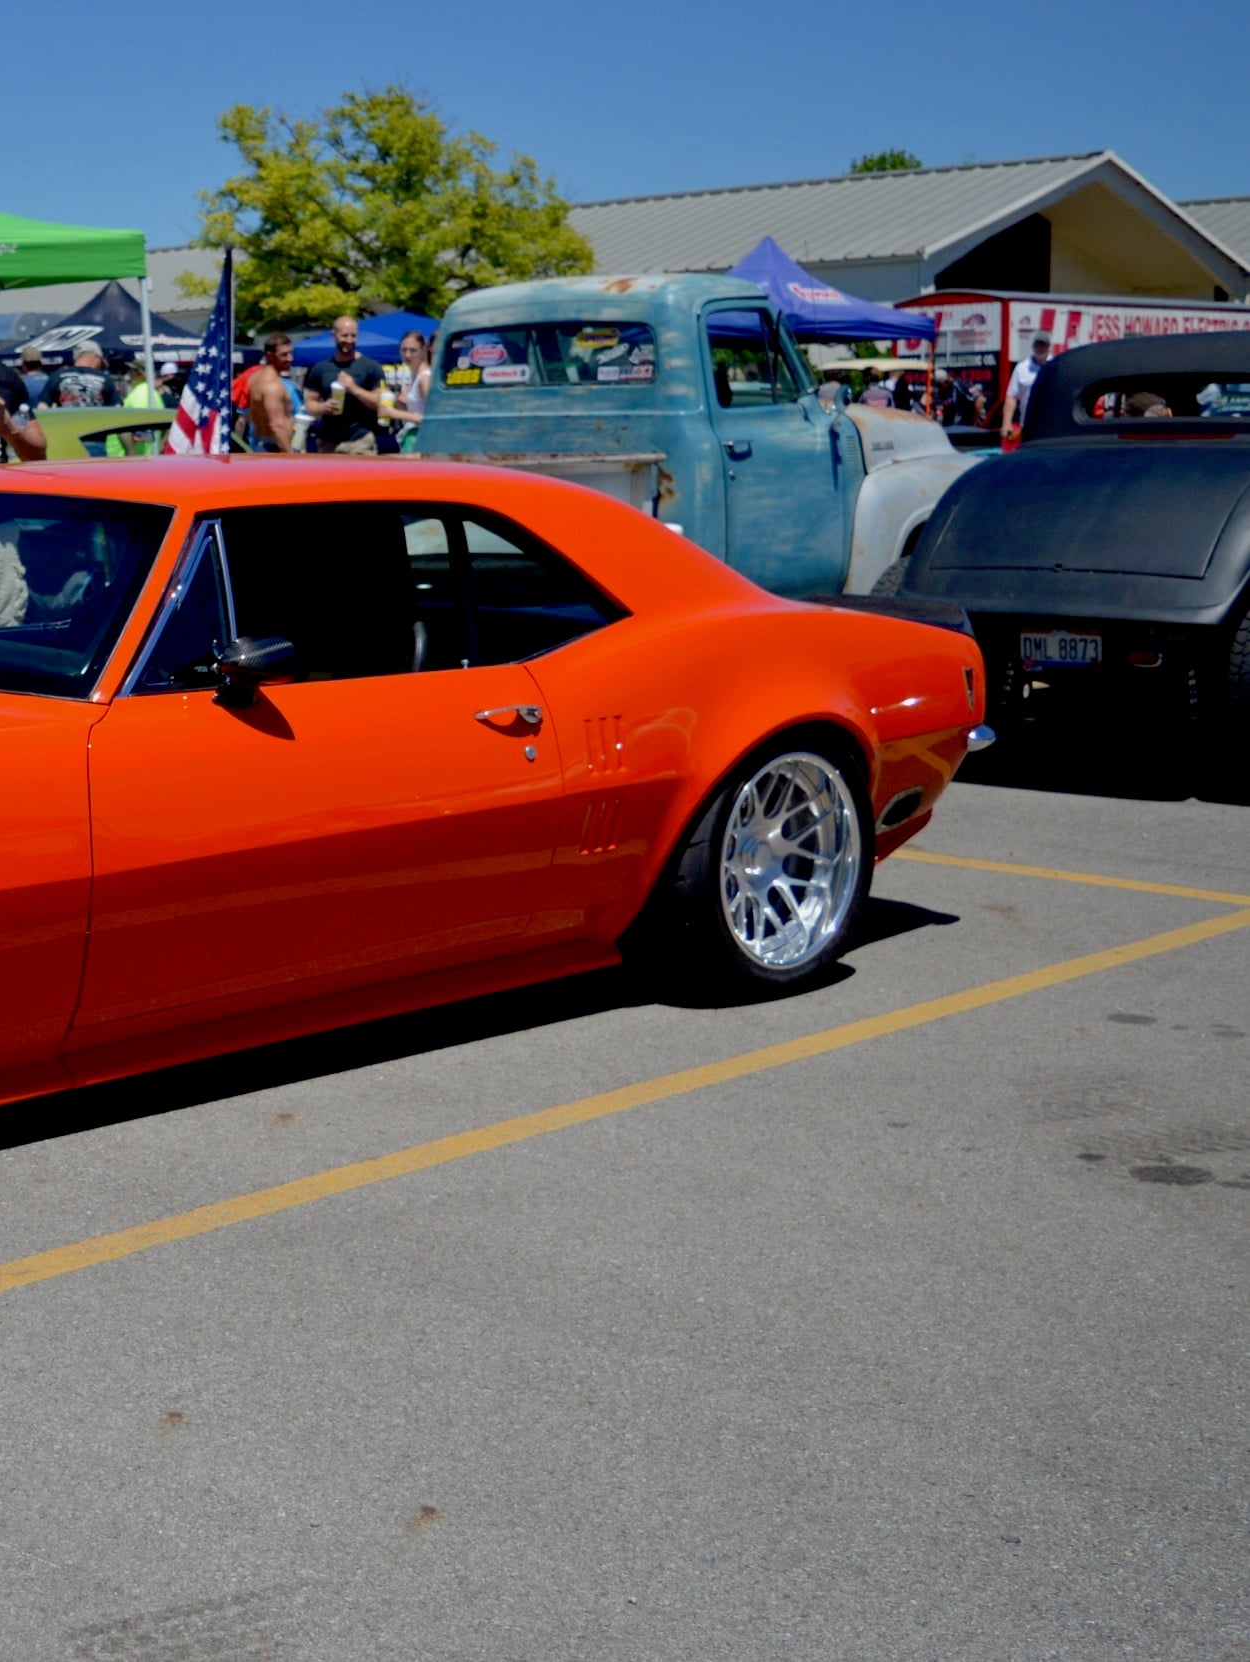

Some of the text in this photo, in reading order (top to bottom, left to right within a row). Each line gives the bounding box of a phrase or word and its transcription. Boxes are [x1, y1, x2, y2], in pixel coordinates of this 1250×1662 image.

[1088, 315, 1121, 339] JESS
[1023, 636, 1100, 661] DML 8873
